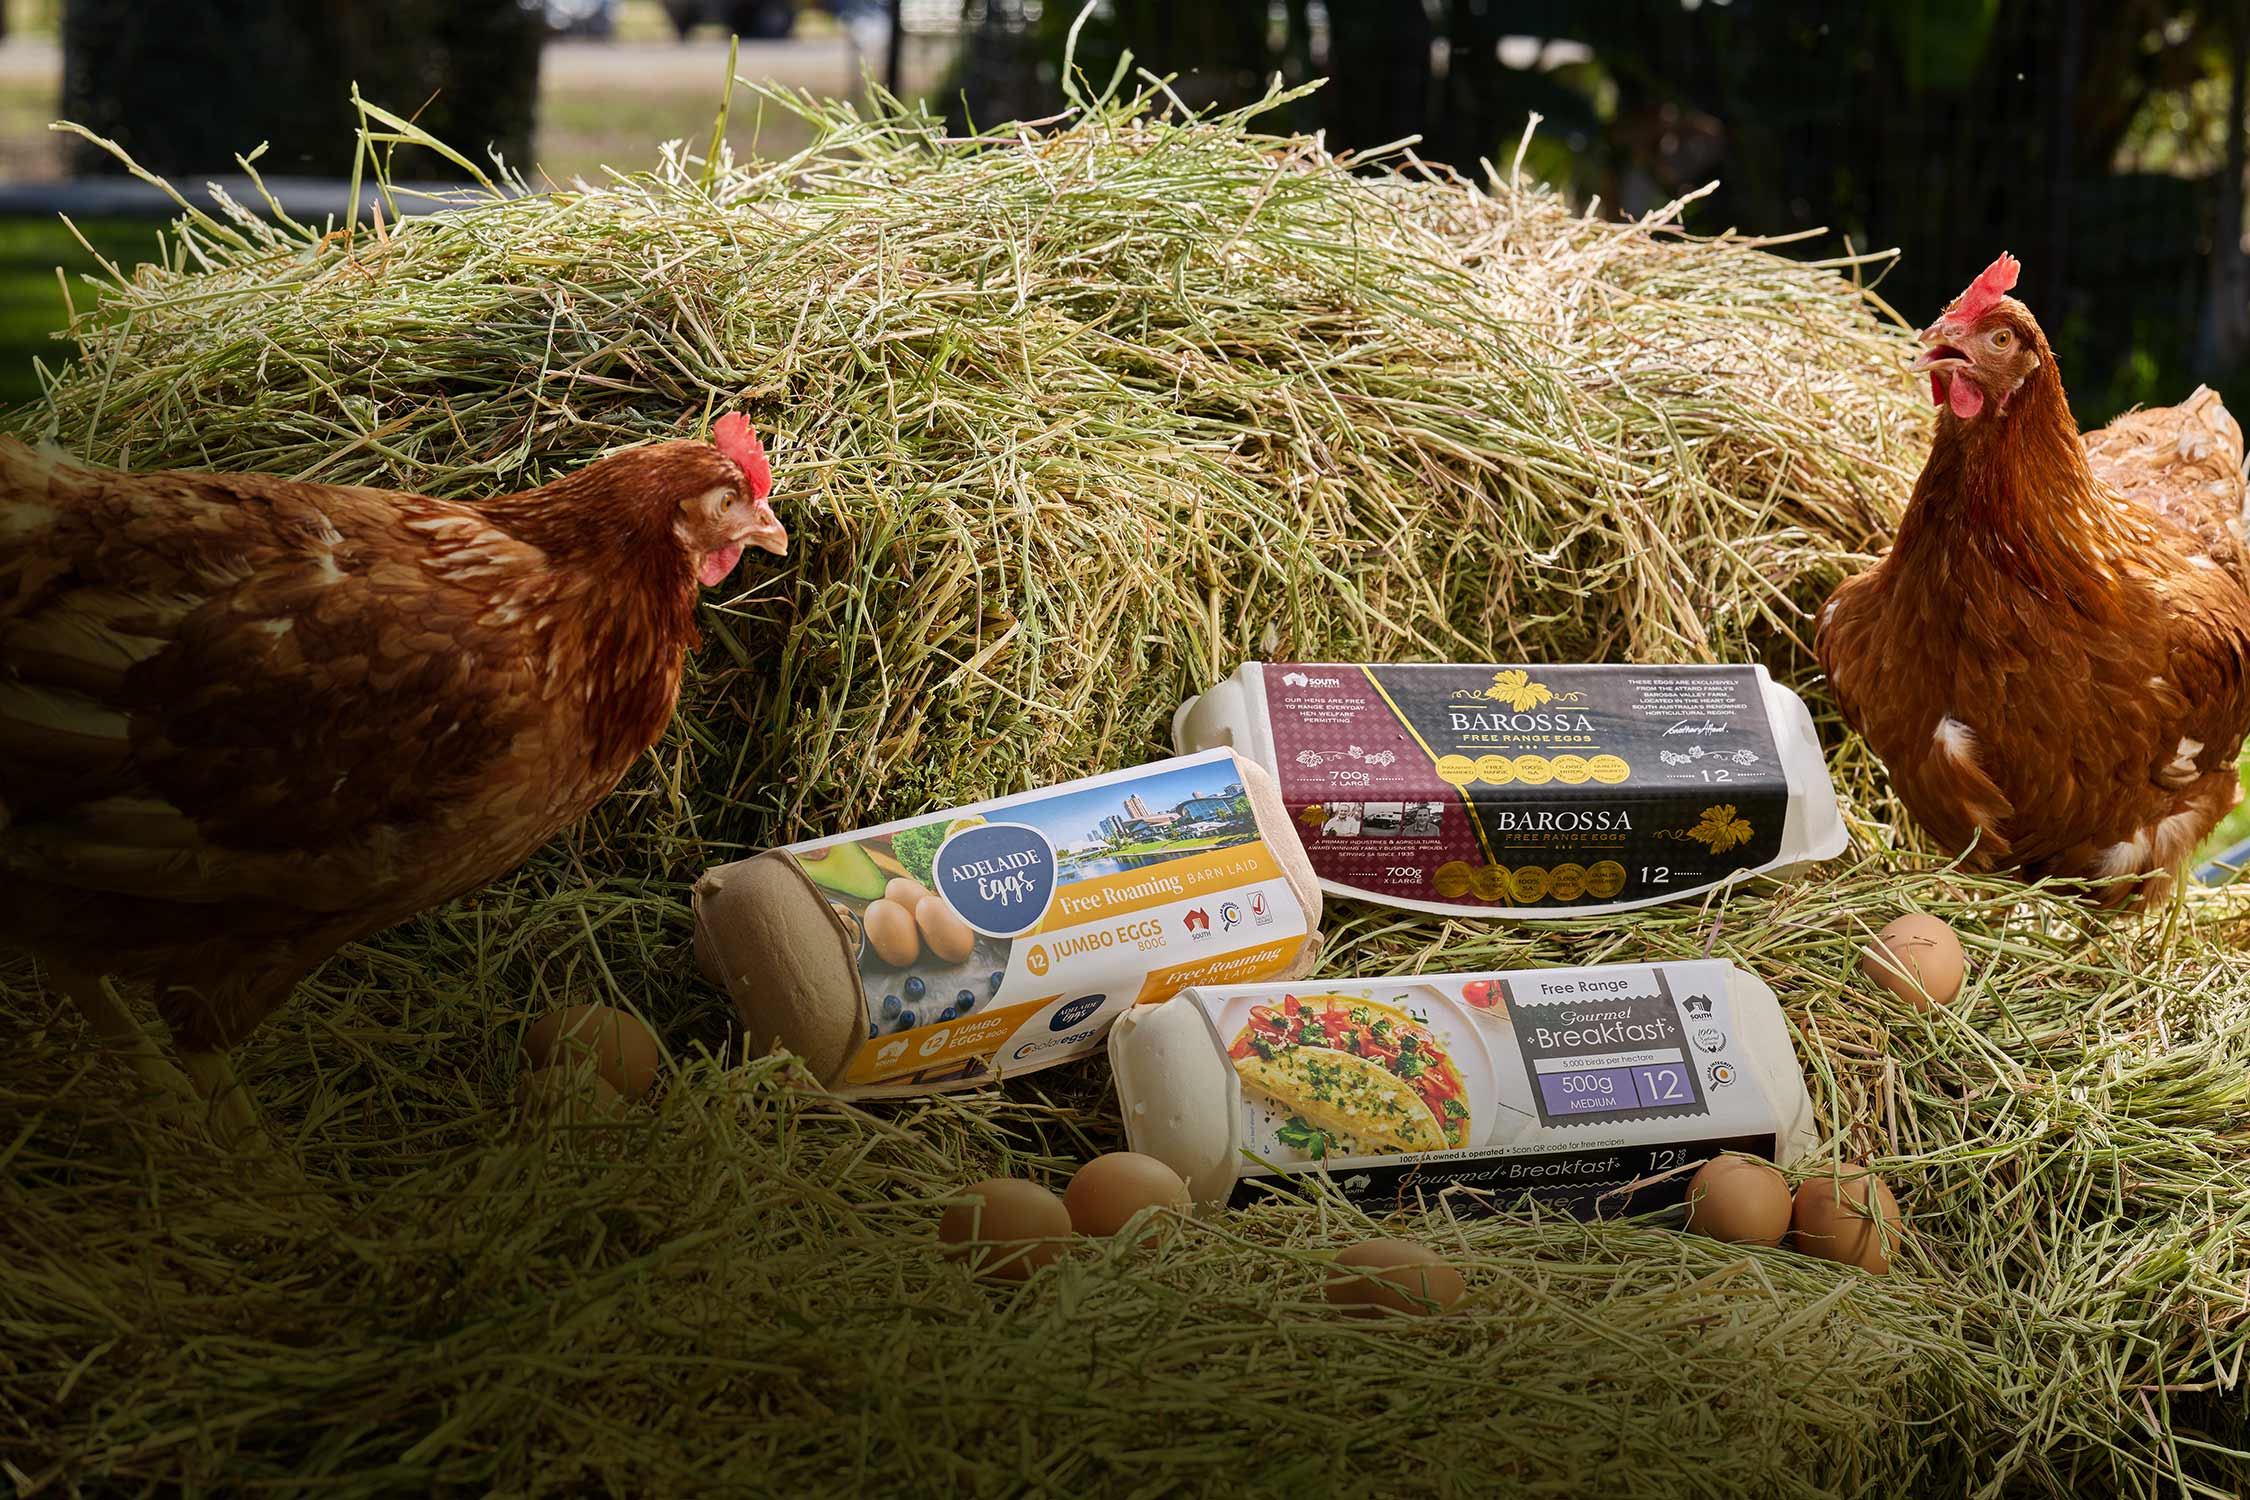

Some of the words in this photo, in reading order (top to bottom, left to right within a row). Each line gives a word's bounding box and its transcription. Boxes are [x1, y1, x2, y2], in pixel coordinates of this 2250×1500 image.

[1450, 713, 1596, 732] BAROSSA
[1329, 771, 1370, 781] 700g
[1701, 769, 1733, 782] 12
[1497, 811, 1633, 832] BAROSSA
[1505, 833, 1540, 841] FREE
[1543, 833, 1588, 841] RANGE
[1591, 833, 1627, 841] EGGS
[951, 849, 1041, 882] ADELAIDE
[1385, 867, 1423, 879] 700g
[1641, 867, 1670, 883] 12
[978, 870, 1036, 906] Eggs
[1060, 895, 1102, 915] Free
[1102, 876, 1184, 904] Roaming
[1186, 865, 1224, 885] BARN
[1227, 858, 1258, 876] LAID
[1028, 954, 1047, 969] 12
[1052, 931, 1114, 962] JUMBO
[1116, 919, 1163, 943] EGGS
[1137, 936, 1167, 952] 800G
[1192, 931, 1212, 940] SOUTH
[1166, 967, 1205, 985] Free
[1207, 947, 1283, 976] Roaming
[1223, 965, 1257, 981] LAID
[1541, 983, 1574, 996] Free
[1578, 979, 1629, 993] Range
[1058, 1001, 1097, 1017] ADELAIDE
[1560, 1005, 1632, 1026] Gourmet
[1690, 1012, 1713, 1020] SOUTH
[926, 1039, 940, 1049] 12
[954, 1017, 1002, 1038] JUMBO
[949, 1031, 984, 1049] EGGS
[1563, 1060, 1584, 1069] 5,000
[1585, 1057, 1606, 1067] birds
[1606, 1057, 1620, 1066] per
[1621, 1053, 1654, 1063] hectare
[1562, 1075, 1614, 1095] 500g
[1643, 1069, 1684, 1101] 12
[1570, 1097, 1617, 1110] MEDIUM
[1400, 1155, 1419, 1163] 100%
[1433, 1152, 1460, 1161] owned
[1469, 1148, 1504, 1160] operated
[1512, 1146, 1532, 1154] Scan
[1533, 1145, 1545, 1153] QR
[1547, 1143, 1568, 1152] code
[1569, 1142, 1580, 1150] for
[1580, 1141, 1597, 1149] free
[1597, 1138, 1625, 1148] recipes
[1650, 1150, 1675, 1171] 12
